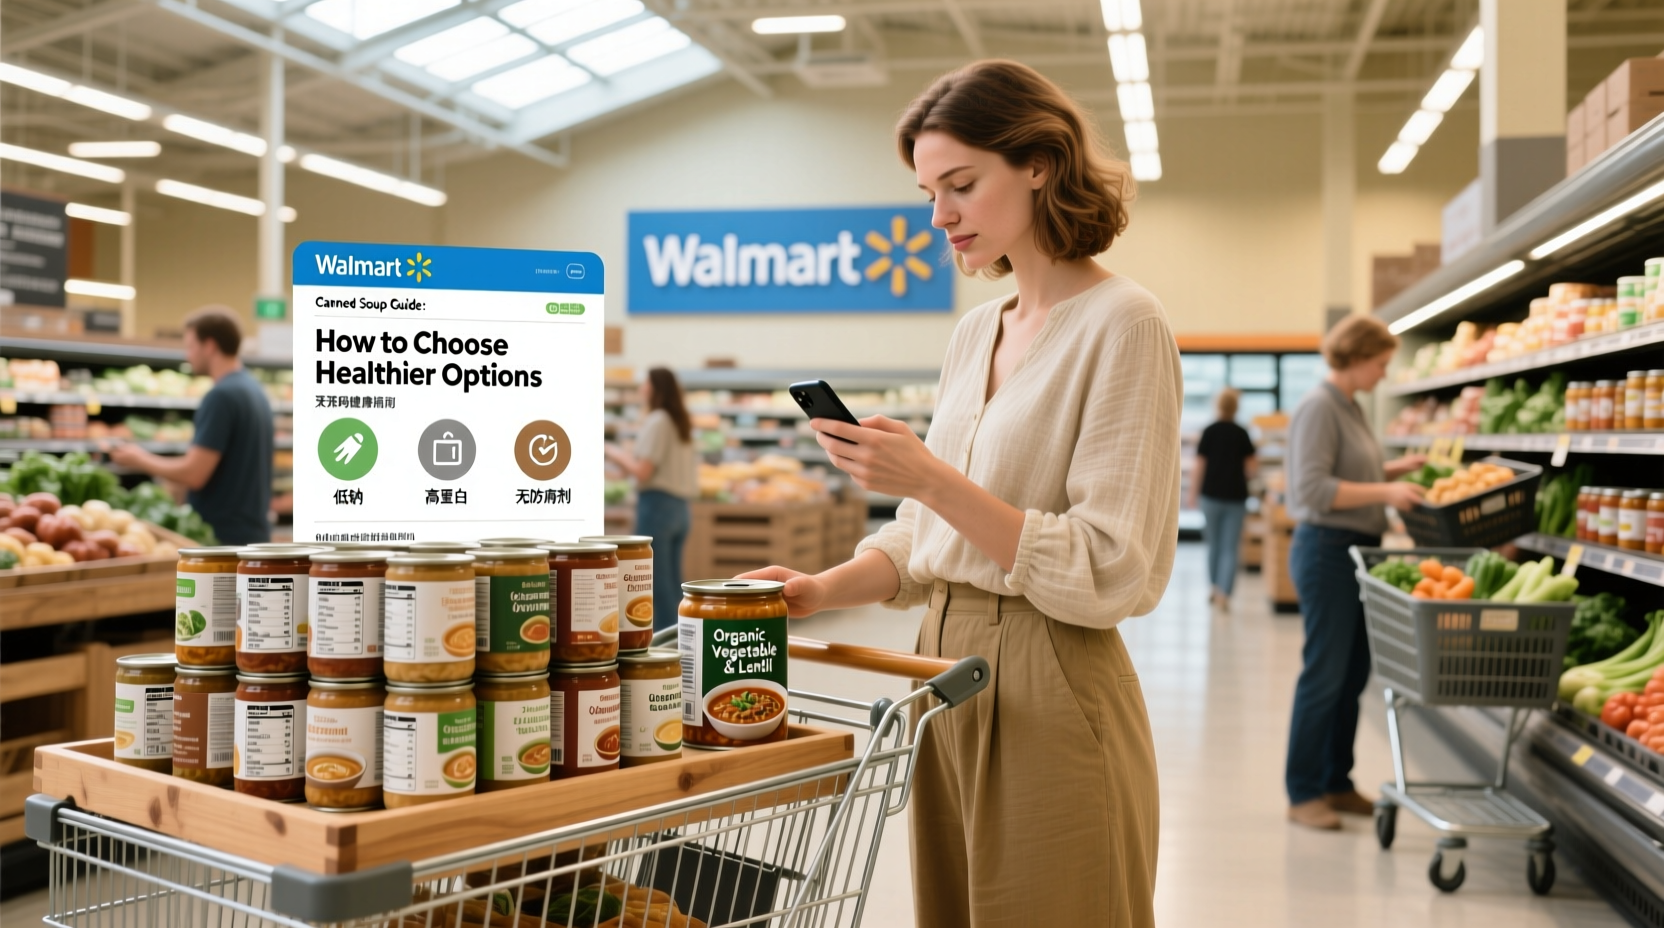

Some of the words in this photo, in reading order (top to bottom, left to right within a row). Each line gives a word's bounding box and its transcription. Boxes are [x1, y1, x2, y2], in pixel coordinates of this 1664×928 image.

[314, 254, 402, 278] Walmart
[643, 230, 861, 287] Walmart
[359, 297, 388, 313] Soup
[390, 298, 426, 311] Guide:
[316, 328, 376, 353] How
[380, 331, 408, 354] to
[413, 330, 509, 356] Choose
[316, 360, 437, 386] Healthier
[441, 361, 543, 393] Options
[713, 627, 766, 646] Organic
[711, 641, 777, 662] Vegetable
[723, 658, 736, 674] &
